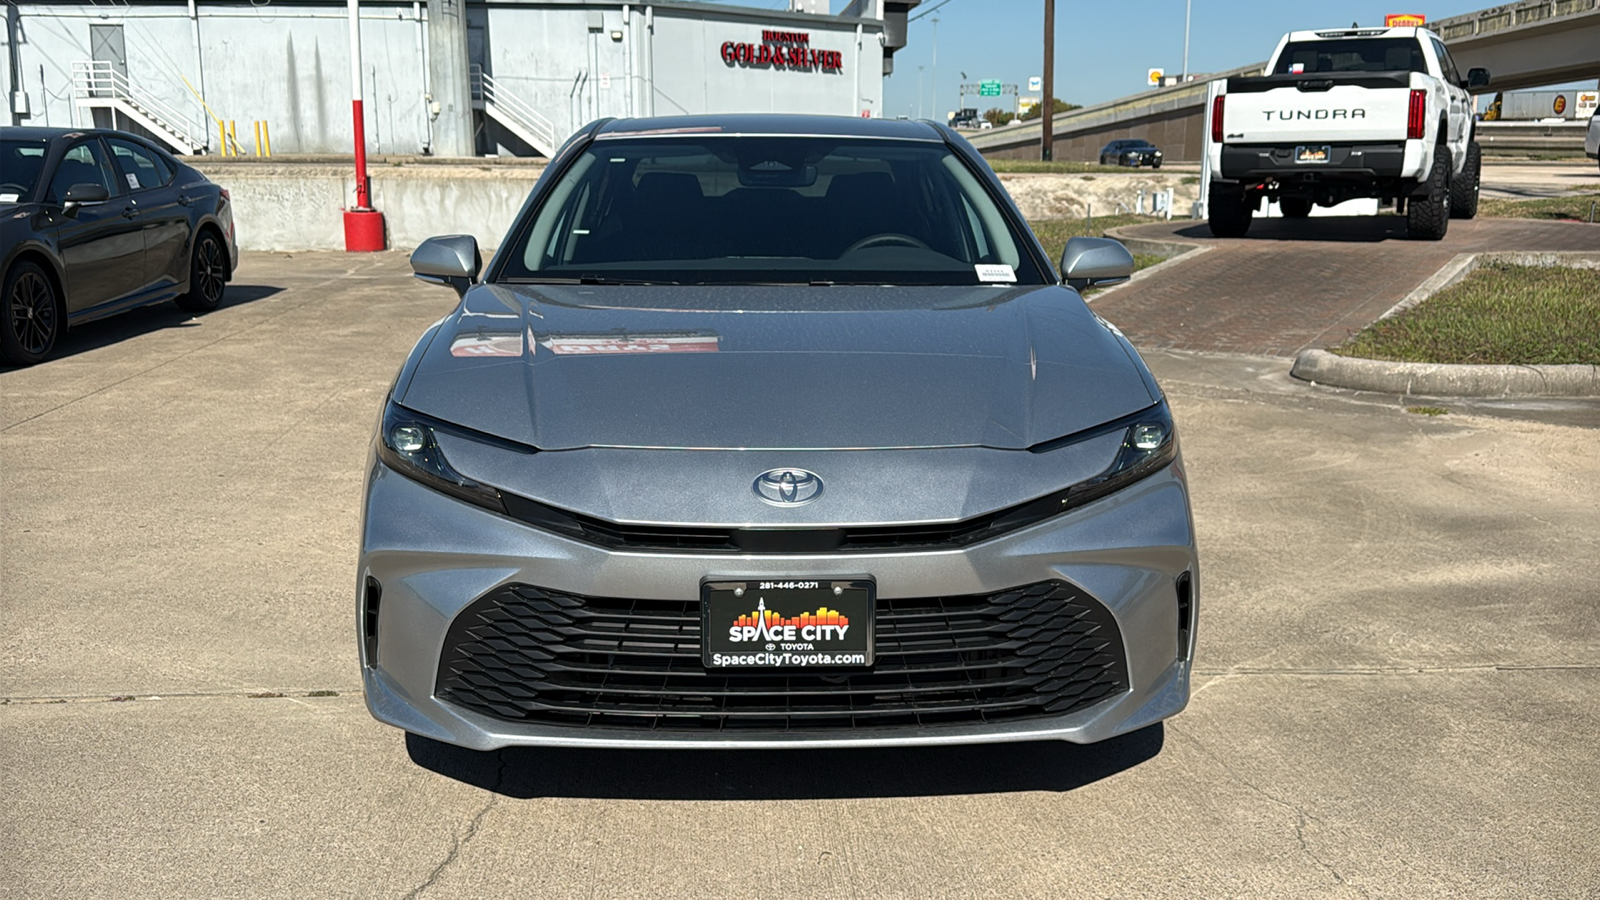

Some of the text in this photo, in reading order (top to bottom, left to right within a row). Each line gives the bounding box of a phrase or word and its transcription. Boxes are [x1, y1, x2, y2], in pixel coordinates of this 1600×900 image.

[762, 30, 809, 43] HOUSTON
[721, 41, 772, 63] GOLD
[788, 47, 842, 68] SILVER
[1262, 109, 1366, 121] TUNDRA
[759, 582, 819, 590] 281-446-0271
[729, 624, 850, 642] SPACE CITY
[780, 643, 814, 651] TOYOTA
[713, 653, 865, 667] SpaceCityToyota.com
